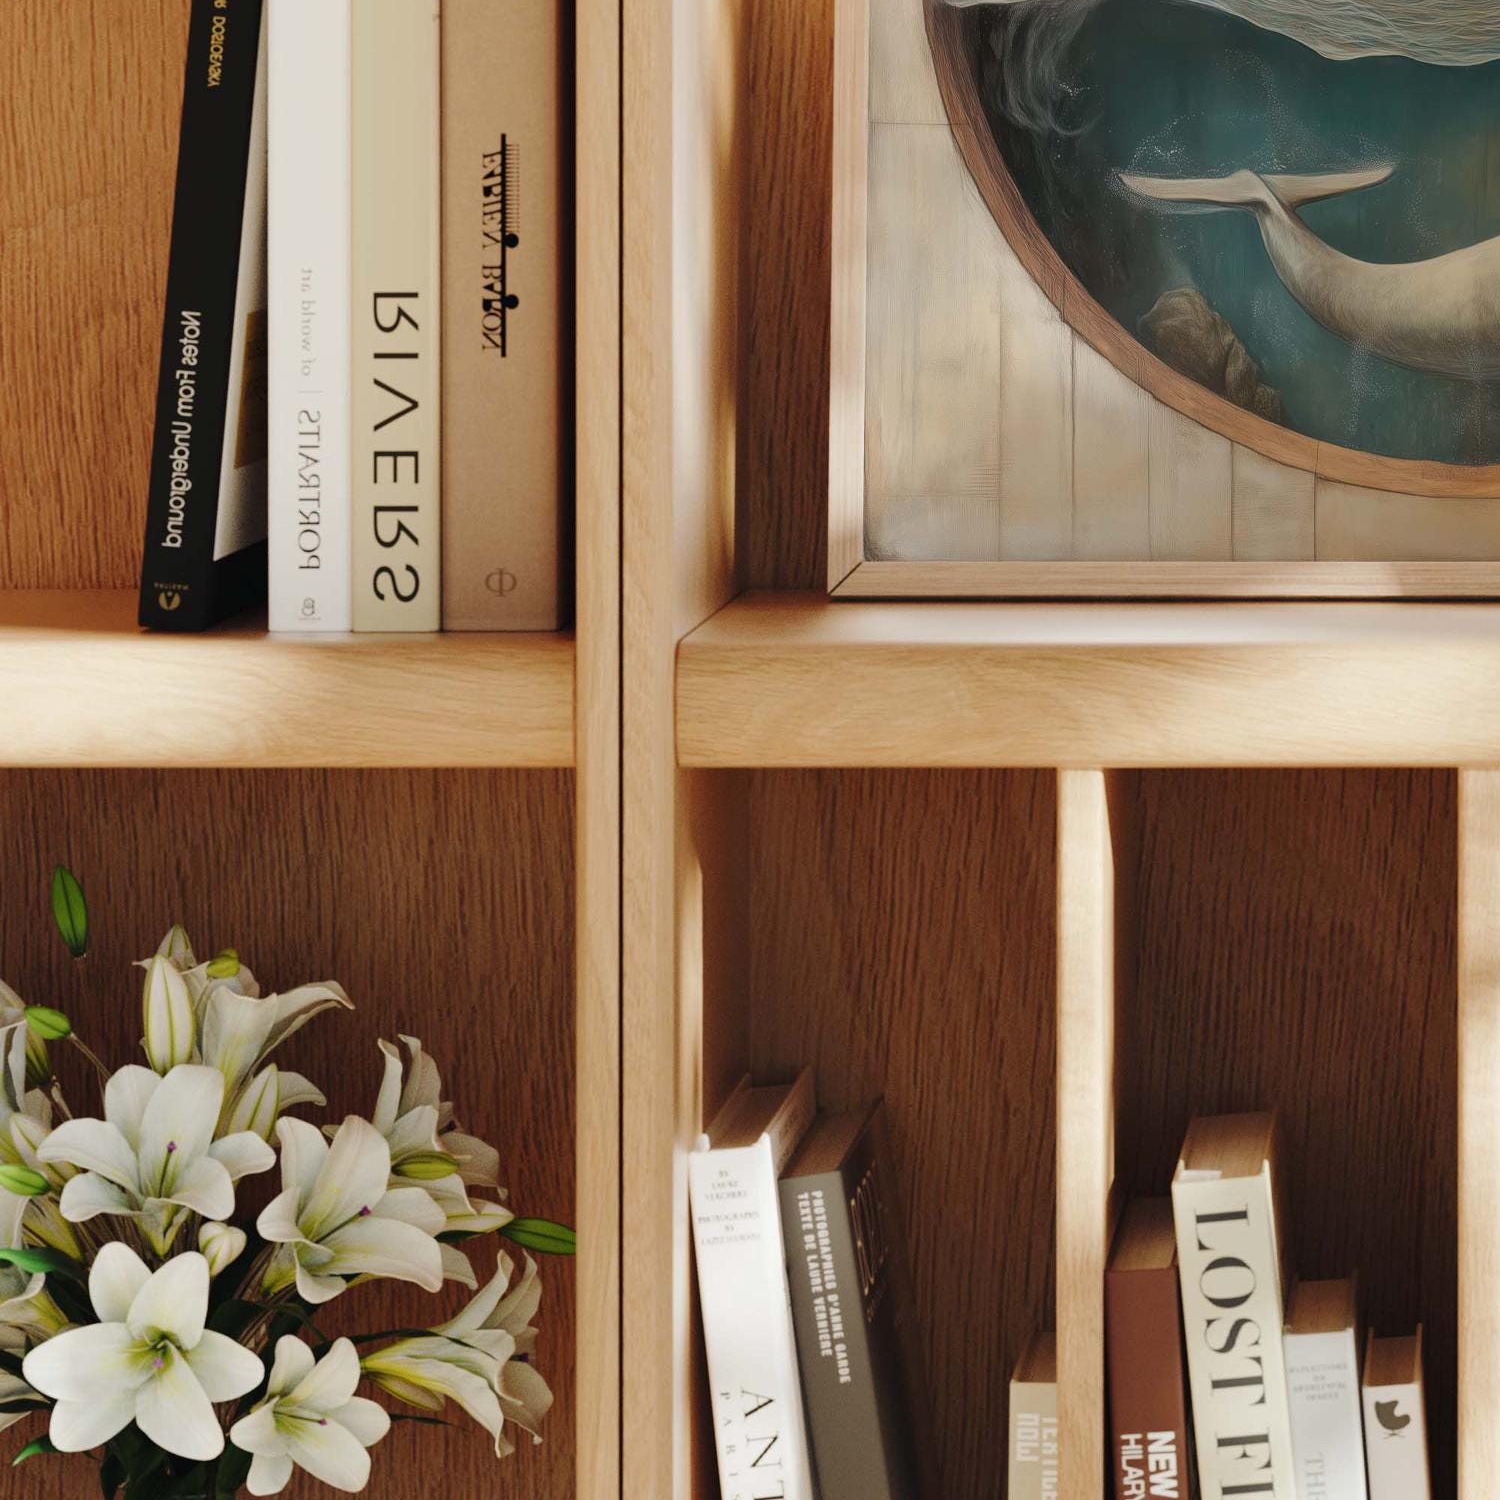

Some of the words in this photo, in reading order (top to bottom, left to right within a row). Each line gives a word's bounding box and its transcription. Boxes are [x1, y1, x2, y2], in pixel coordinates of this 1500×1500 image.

[797, 1192, 812, 1230] TEXTE
[803, 1234, 817, 1251] DE
[811, 1190, 838, 1290] PHOTOGRAPHIES
[806, 1254, 826, 1294] LAURE
[1193, 1203, 1266, 1406] LOST
[1146, 1431, 1180, 1499] NEW
